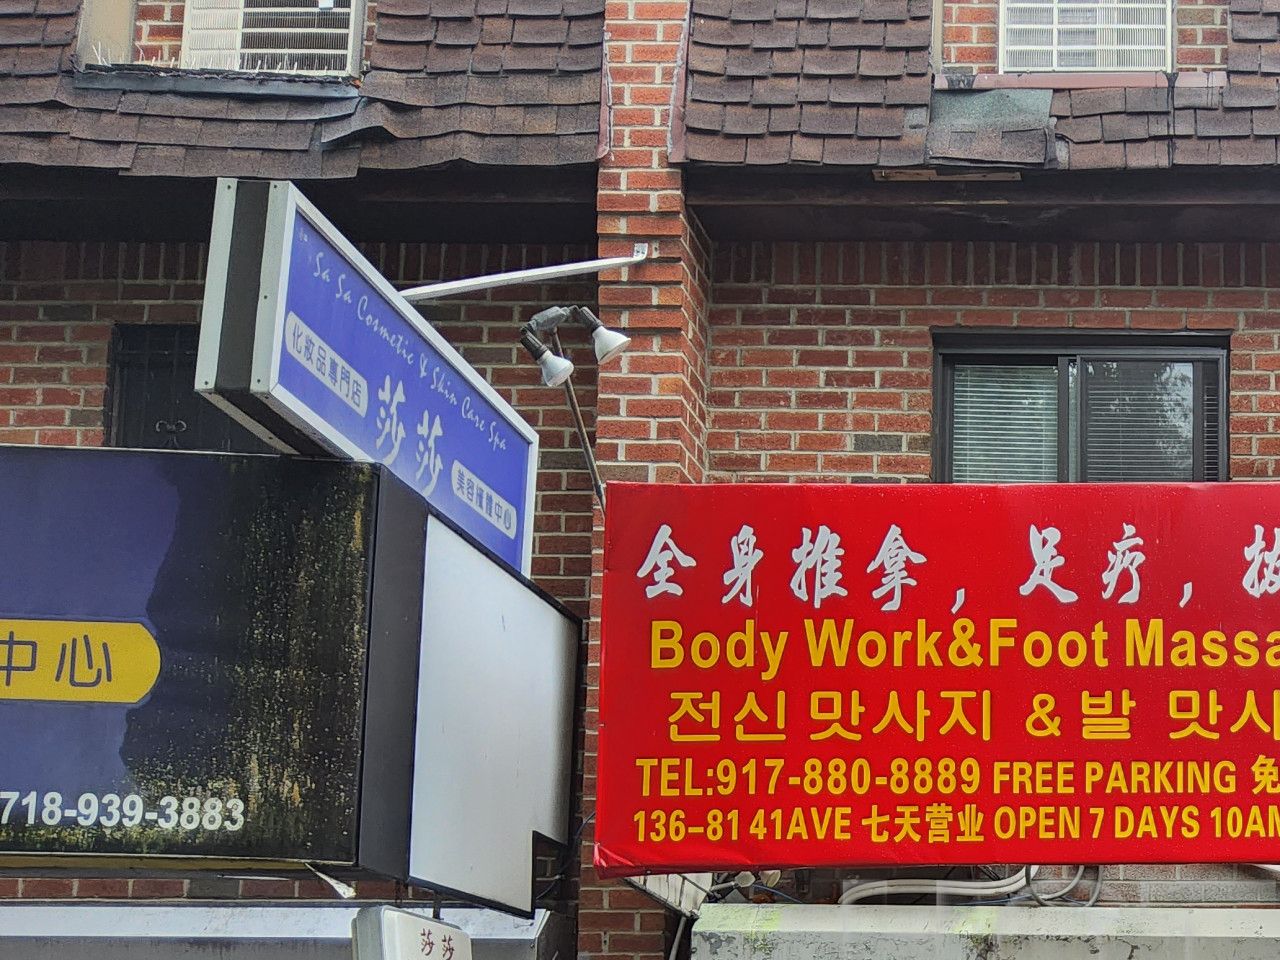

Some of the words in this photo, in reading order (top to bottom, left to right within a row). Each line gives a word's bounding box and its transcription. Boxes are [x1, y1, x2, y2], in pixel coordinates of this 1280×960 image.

[313, 251, 331, 283] Sa
[336, 273, 352, 304] Sa
[357, 295, 414, 365] Cosmetic
[430, 366, 458, 406] Skin
[461, 396, 485, 432] Care
[488, 421, 507, 451] Spa
[650, 619, 789, 681] Body
[667, 690, 787, 743] 전신
[809, 689, 992, 743] 맛사지
[1025, 692, 1062, 738] &
[1080, 688, 1137, 741] 발
[992, 761, 1075, 795] FREE
[1084, 759, 1237, 795] PARKING
[0, 790, 245, 832] 718-939-3883
[861, 803, 985, 844] 七天营业
[993, 806, 1081, 840] OPEN
[1089, 807, 1105, 839] 7
[1114, 806, 1201, 839] DAYS
